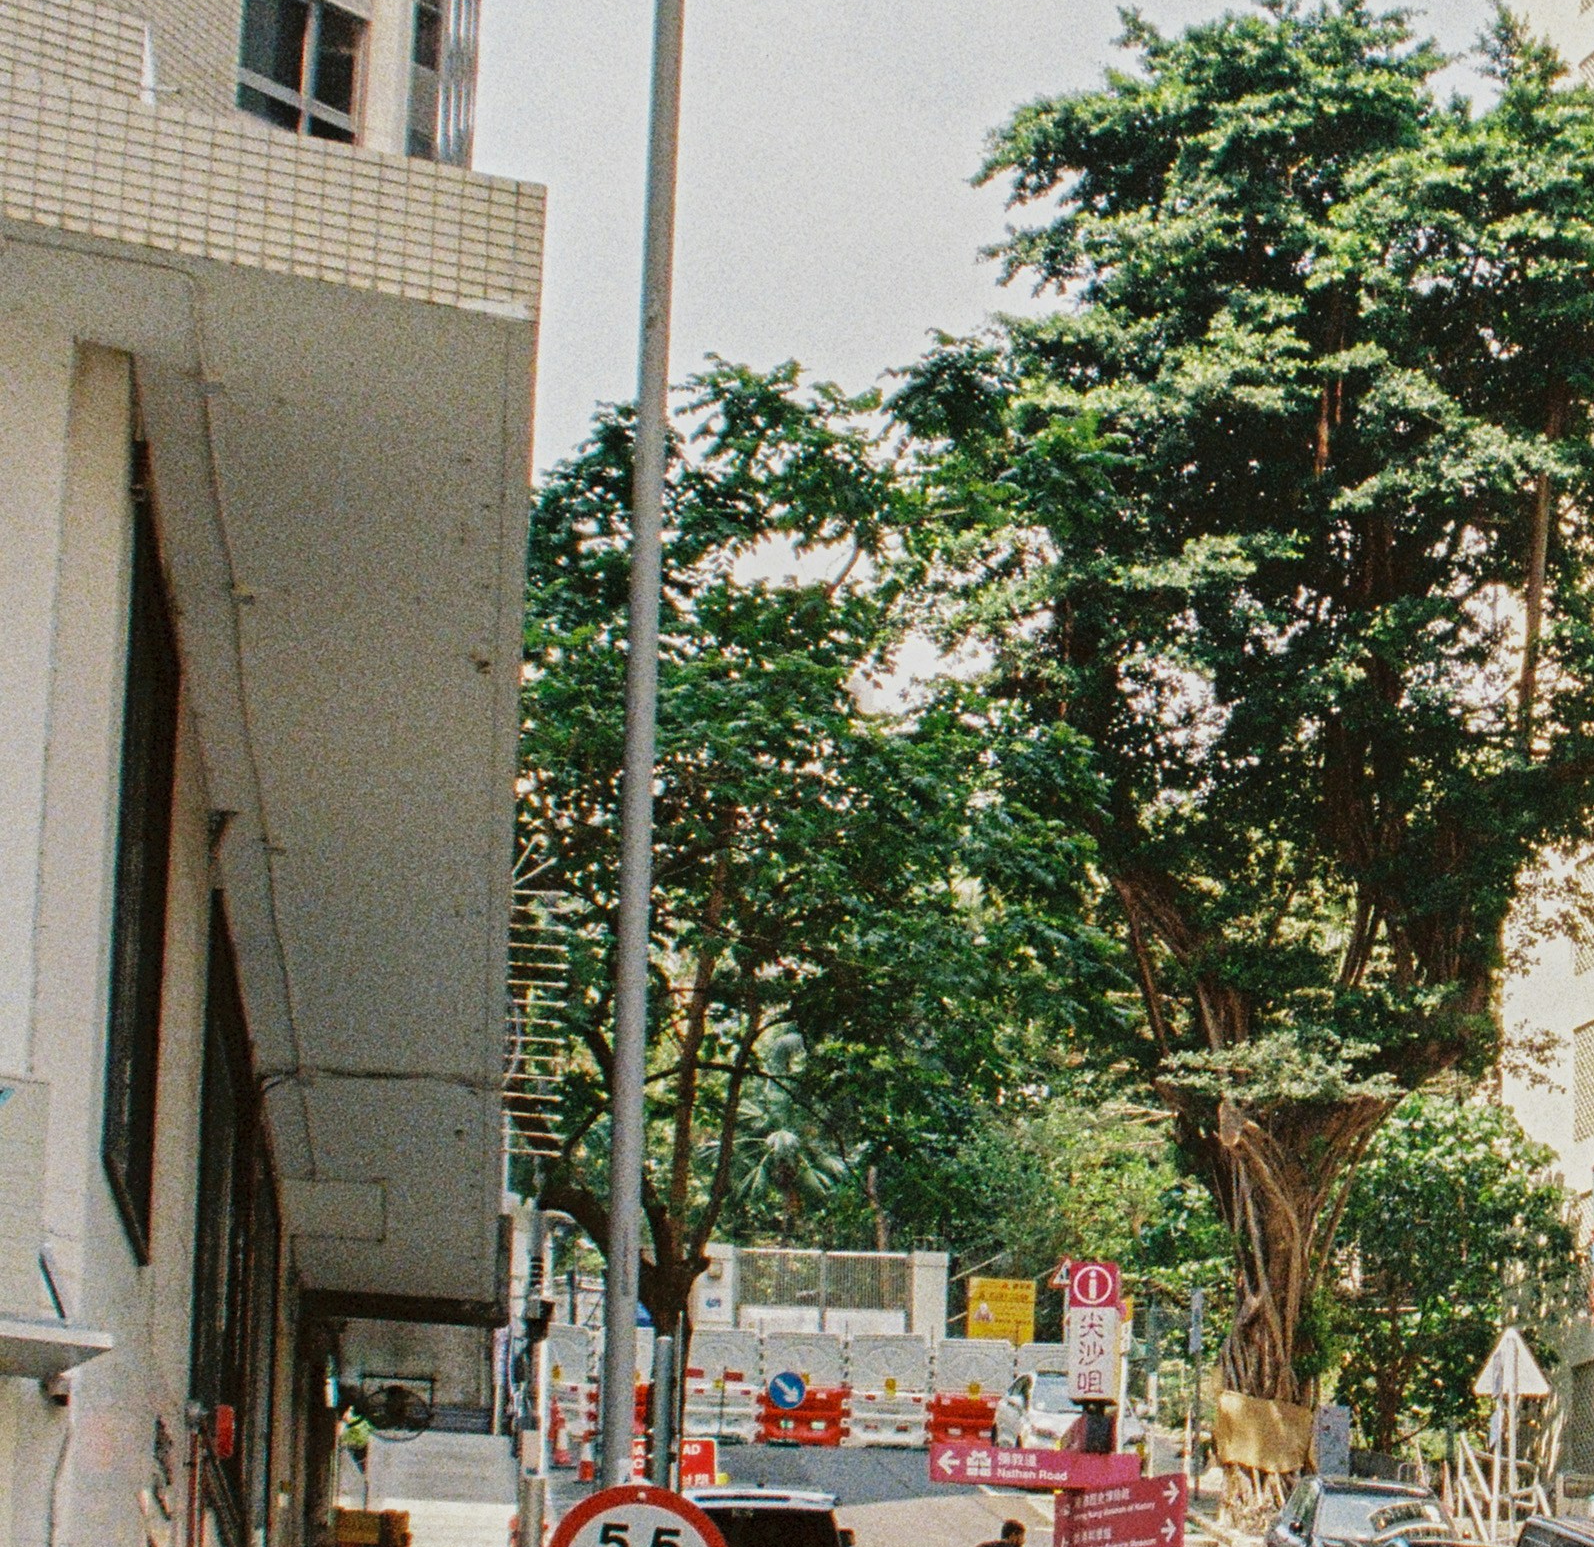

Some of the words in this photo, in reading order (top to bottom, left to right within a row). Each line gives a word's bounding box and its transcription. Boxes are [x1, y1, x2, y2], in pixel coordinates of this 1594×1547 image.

[1076, 1311, 1105, 1396] 尖沙咀
[997, 1467, 1036, 1480] Nathan
[1038, 1469, 1068, 1481] Road
